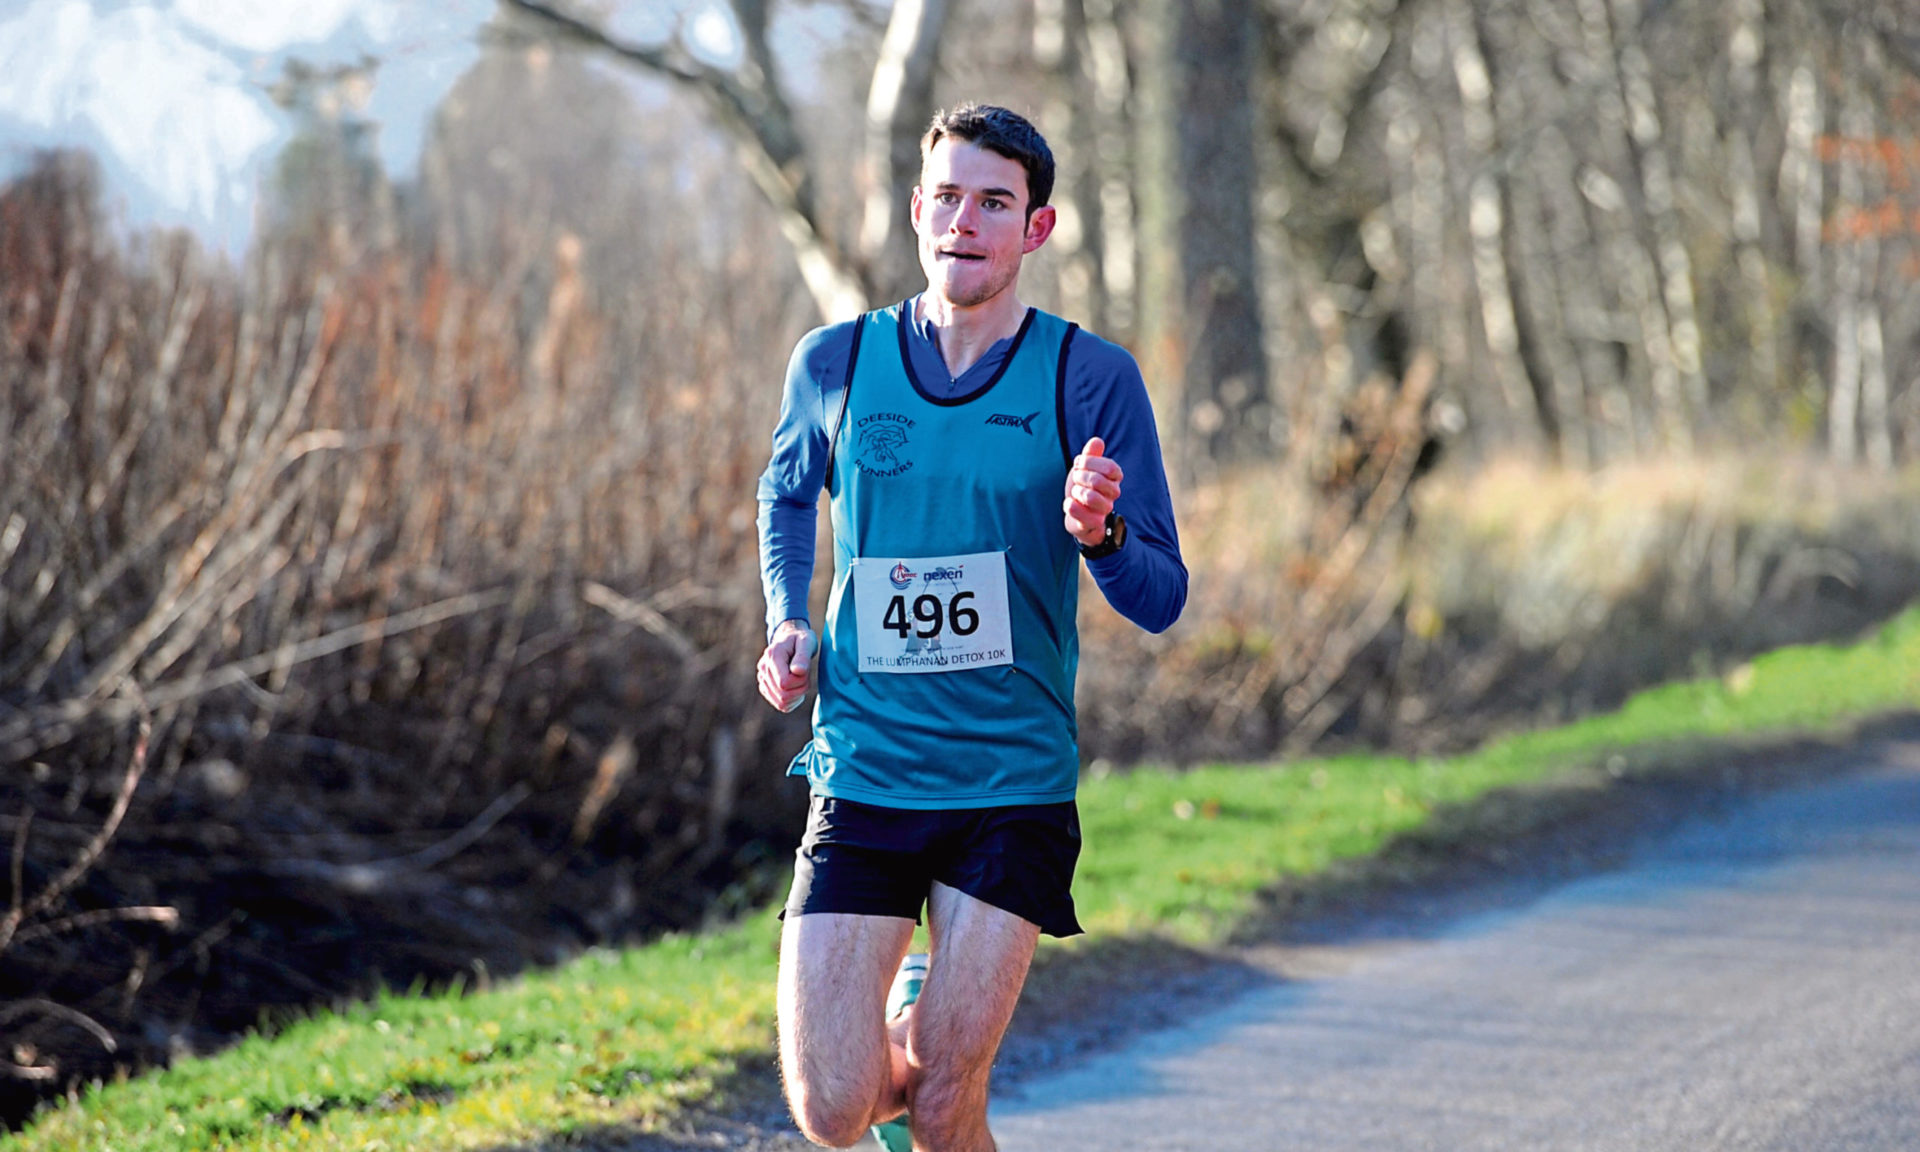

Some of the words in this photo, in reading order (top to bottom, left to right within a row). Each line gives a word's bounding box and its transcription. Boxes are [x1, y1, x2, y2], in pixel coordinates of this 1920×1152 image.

[857, 413, 917, 430] DEESIDE
[854, 458, 913, 477] RUNNERS
[923, 569, 963, 581] nexen
[882, 591, 980, 639] 496
[867, 656, 884, 667] THE
[886, 655, 948, 667] LUMPHANAN
[951, 651, 985, 664] DETOX
[988, 648, 1006, 660] 10K
